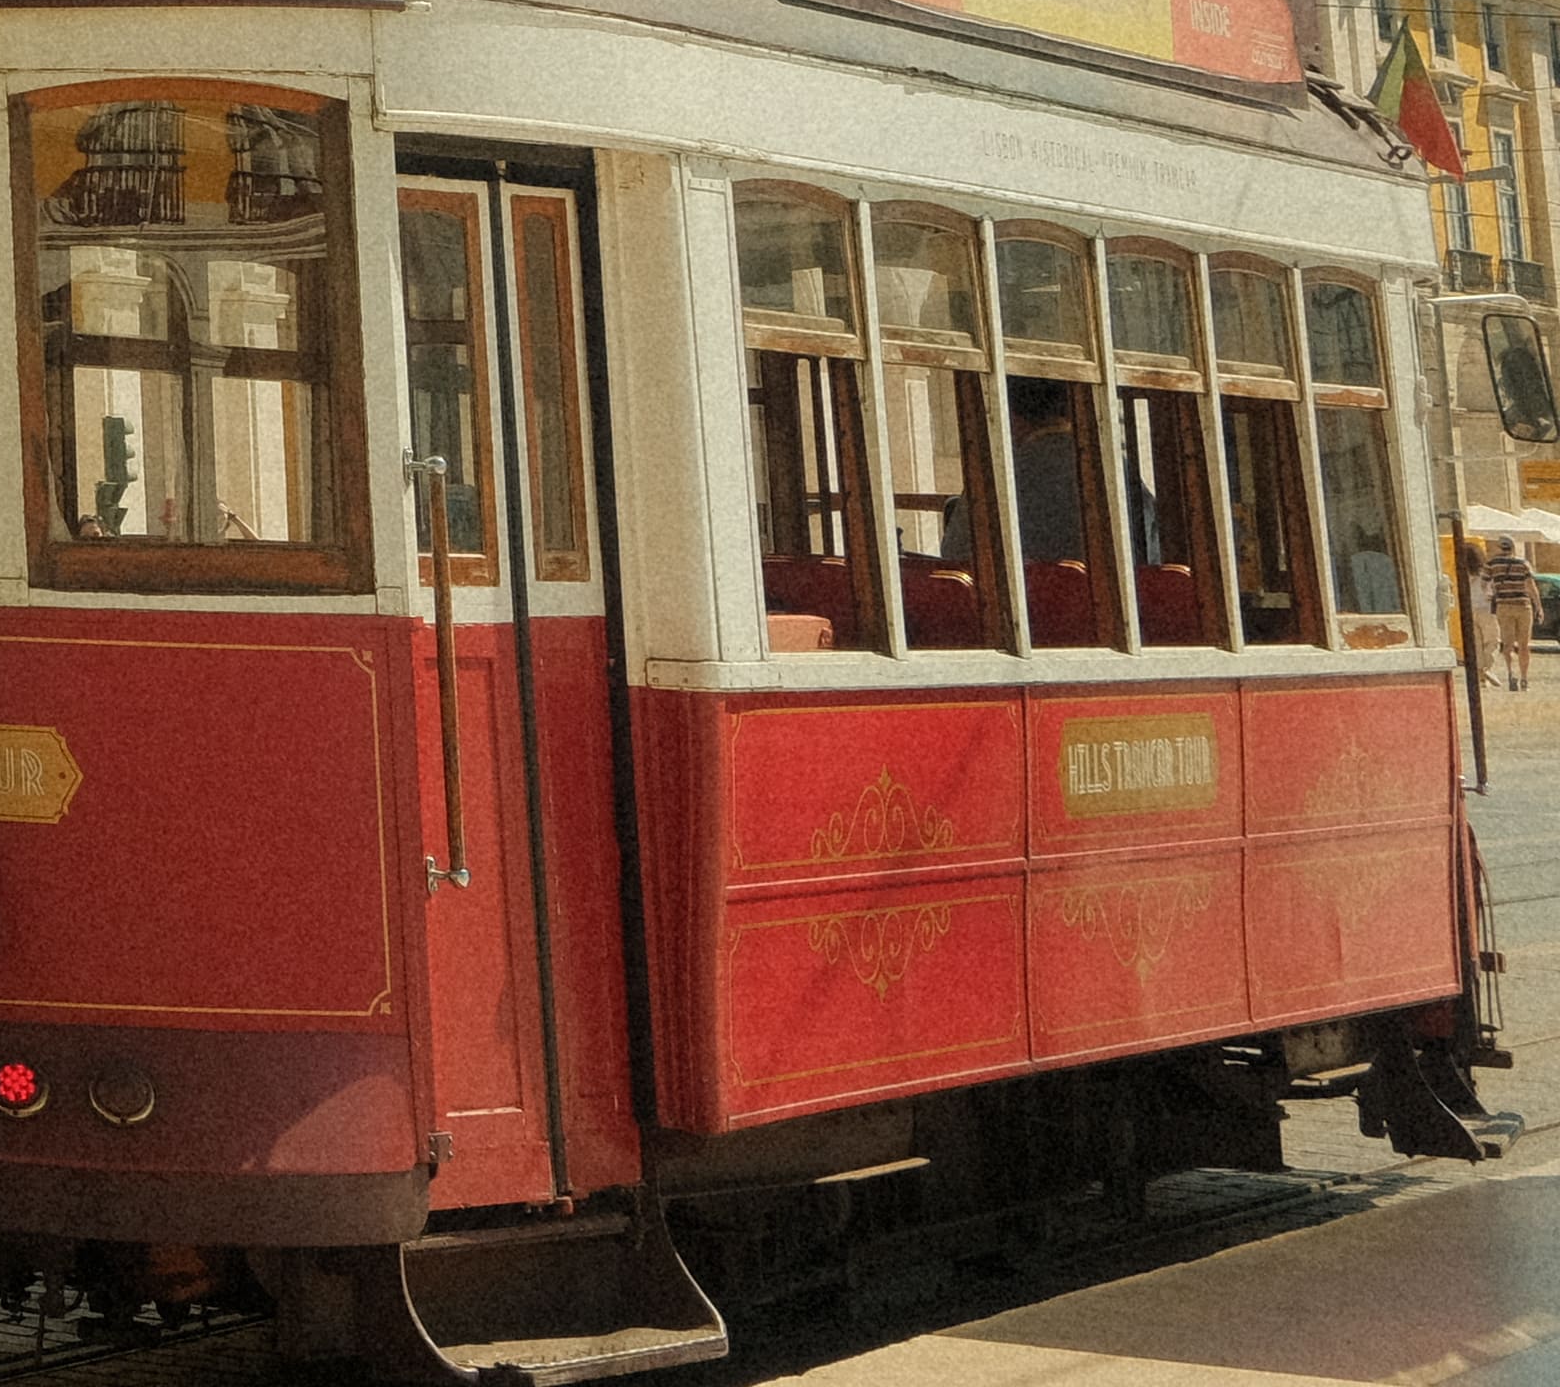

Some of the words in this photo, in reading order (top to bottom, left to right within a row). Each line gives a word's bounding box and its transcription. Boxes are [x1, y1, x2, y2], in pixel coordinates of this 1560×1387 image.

[1068, 742, 1113, 795] HILLS
[1113, 738, 1175, 791] TRAMCAR
[1175, 735, 1213, 787] TOUR
